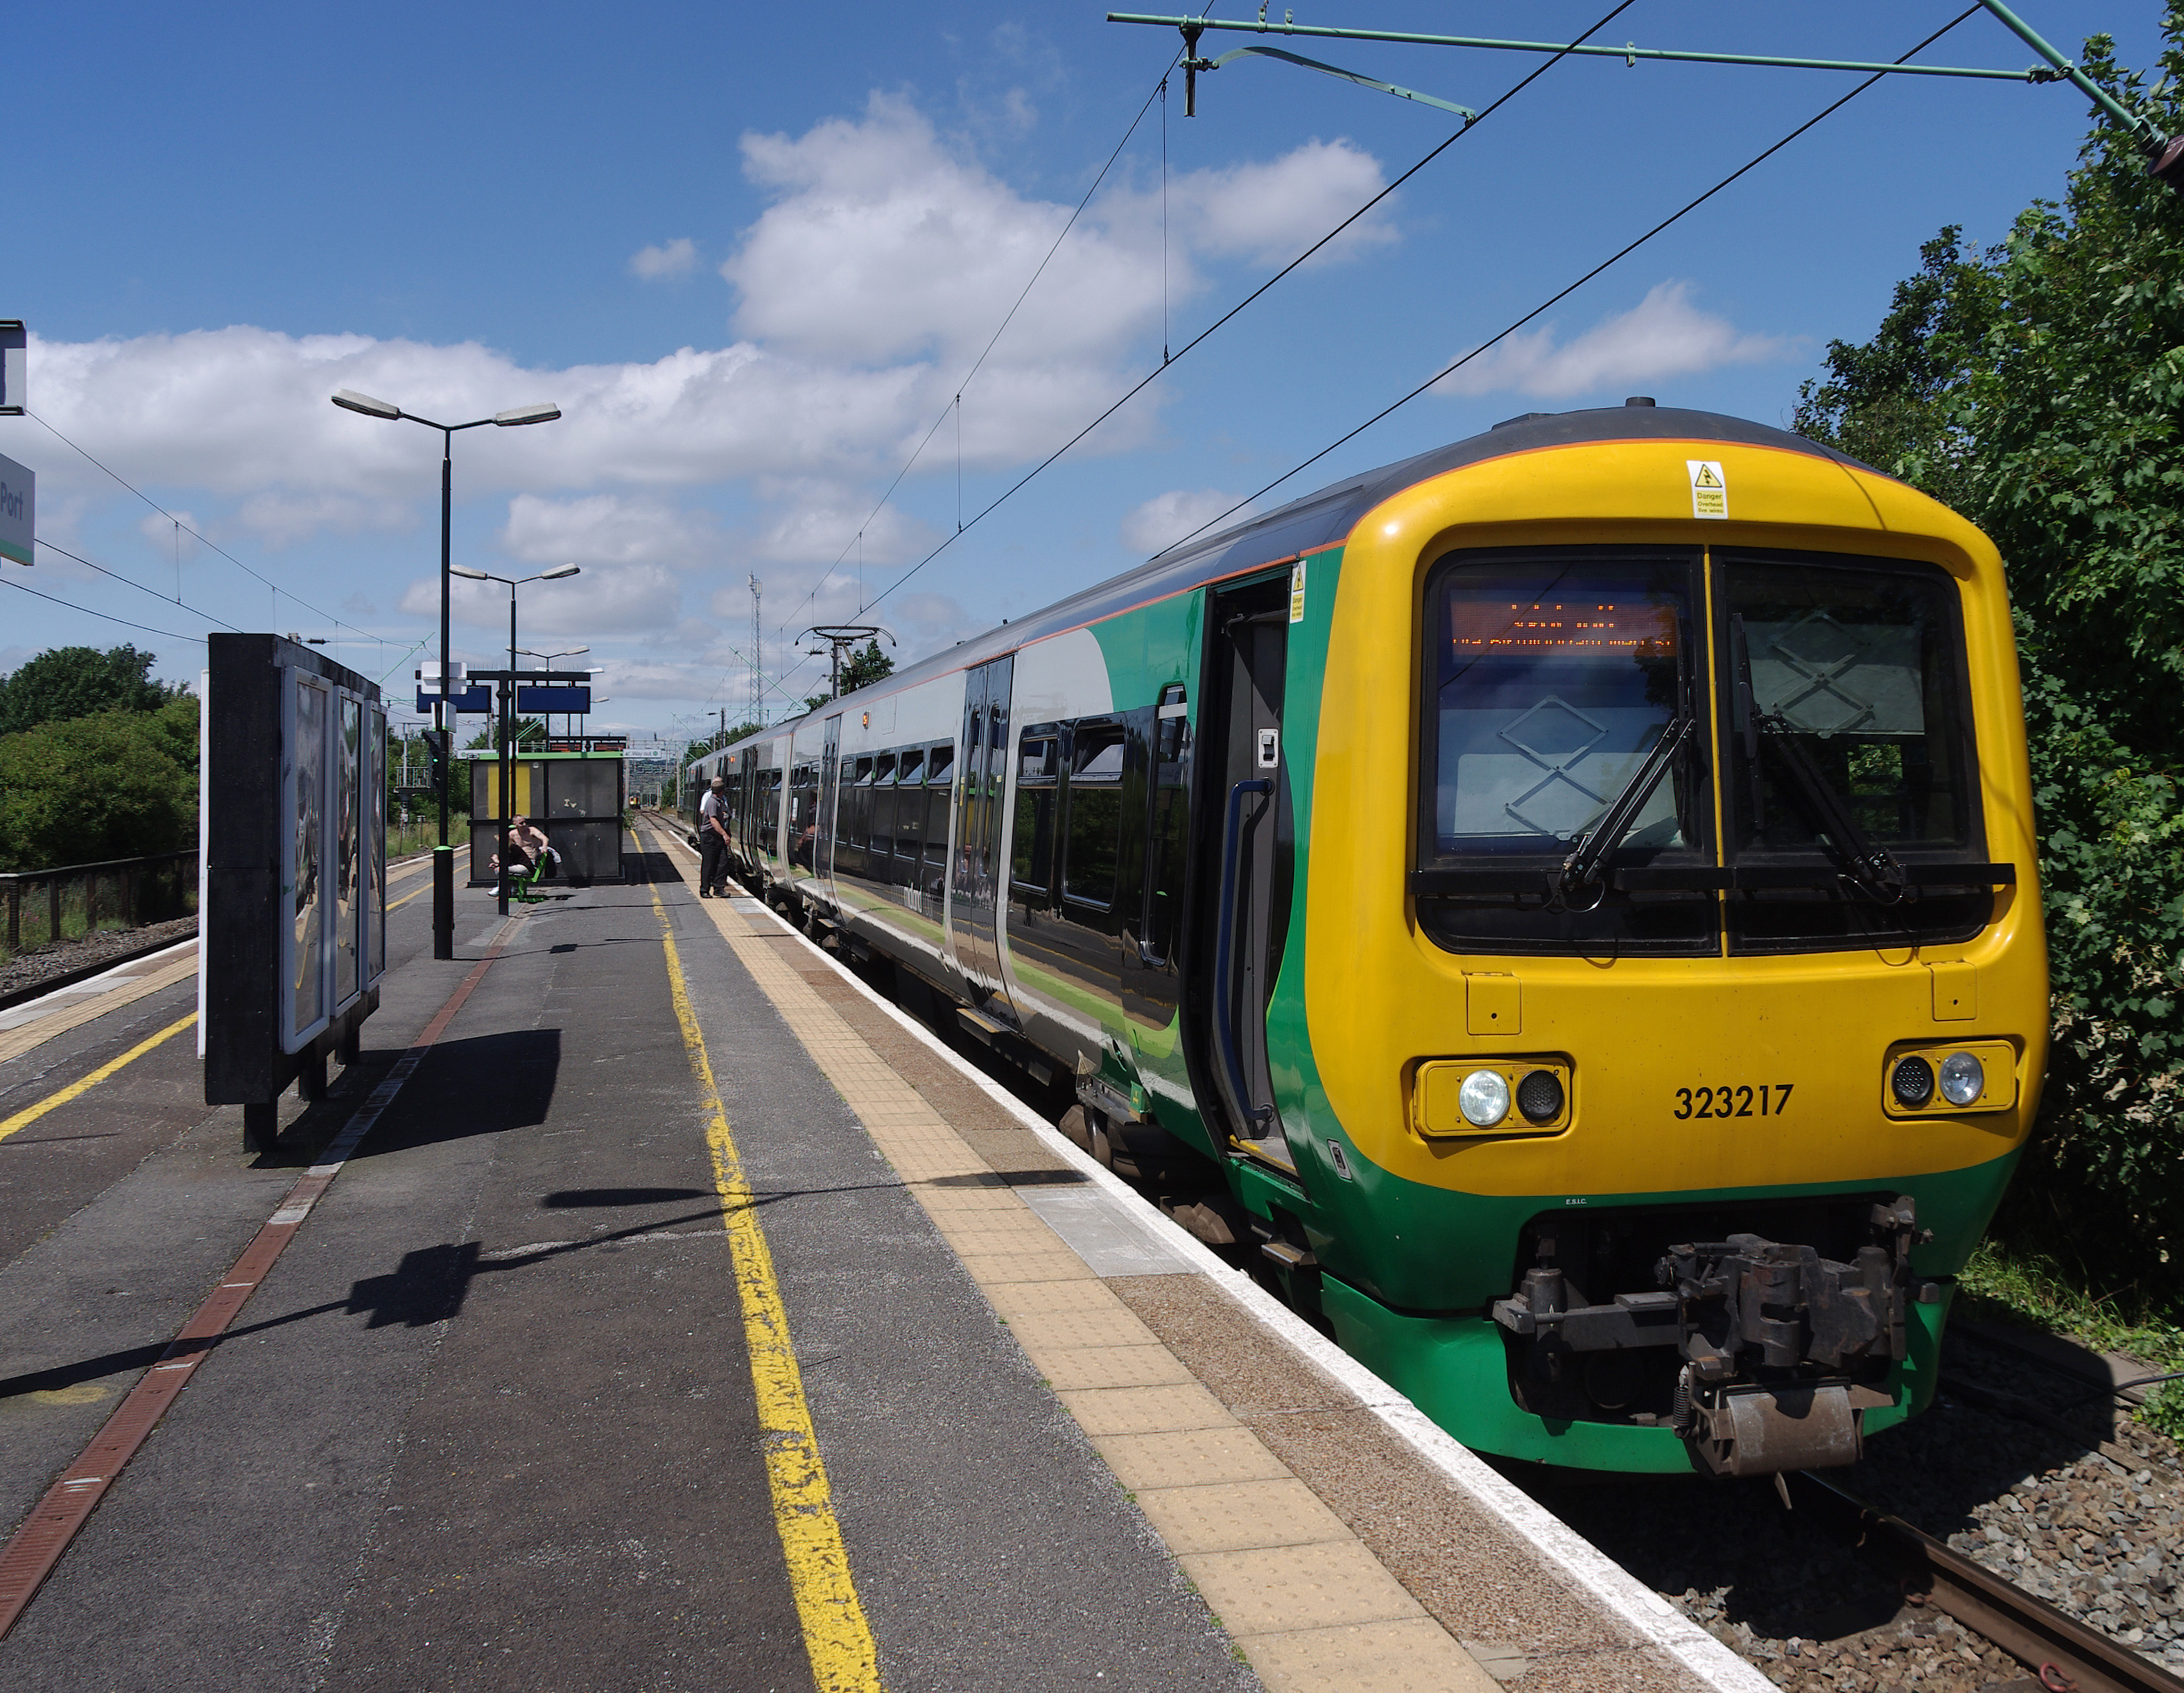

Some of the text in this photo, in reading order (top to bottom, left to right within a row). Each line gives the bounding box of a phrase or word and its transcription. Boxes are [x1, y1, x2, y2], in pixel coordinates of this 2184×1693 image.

[1, 481, 23, 521] Port
[1697, 492, 1722, 501] Danger
[1674, 1084, 1794, 1120] 323217
